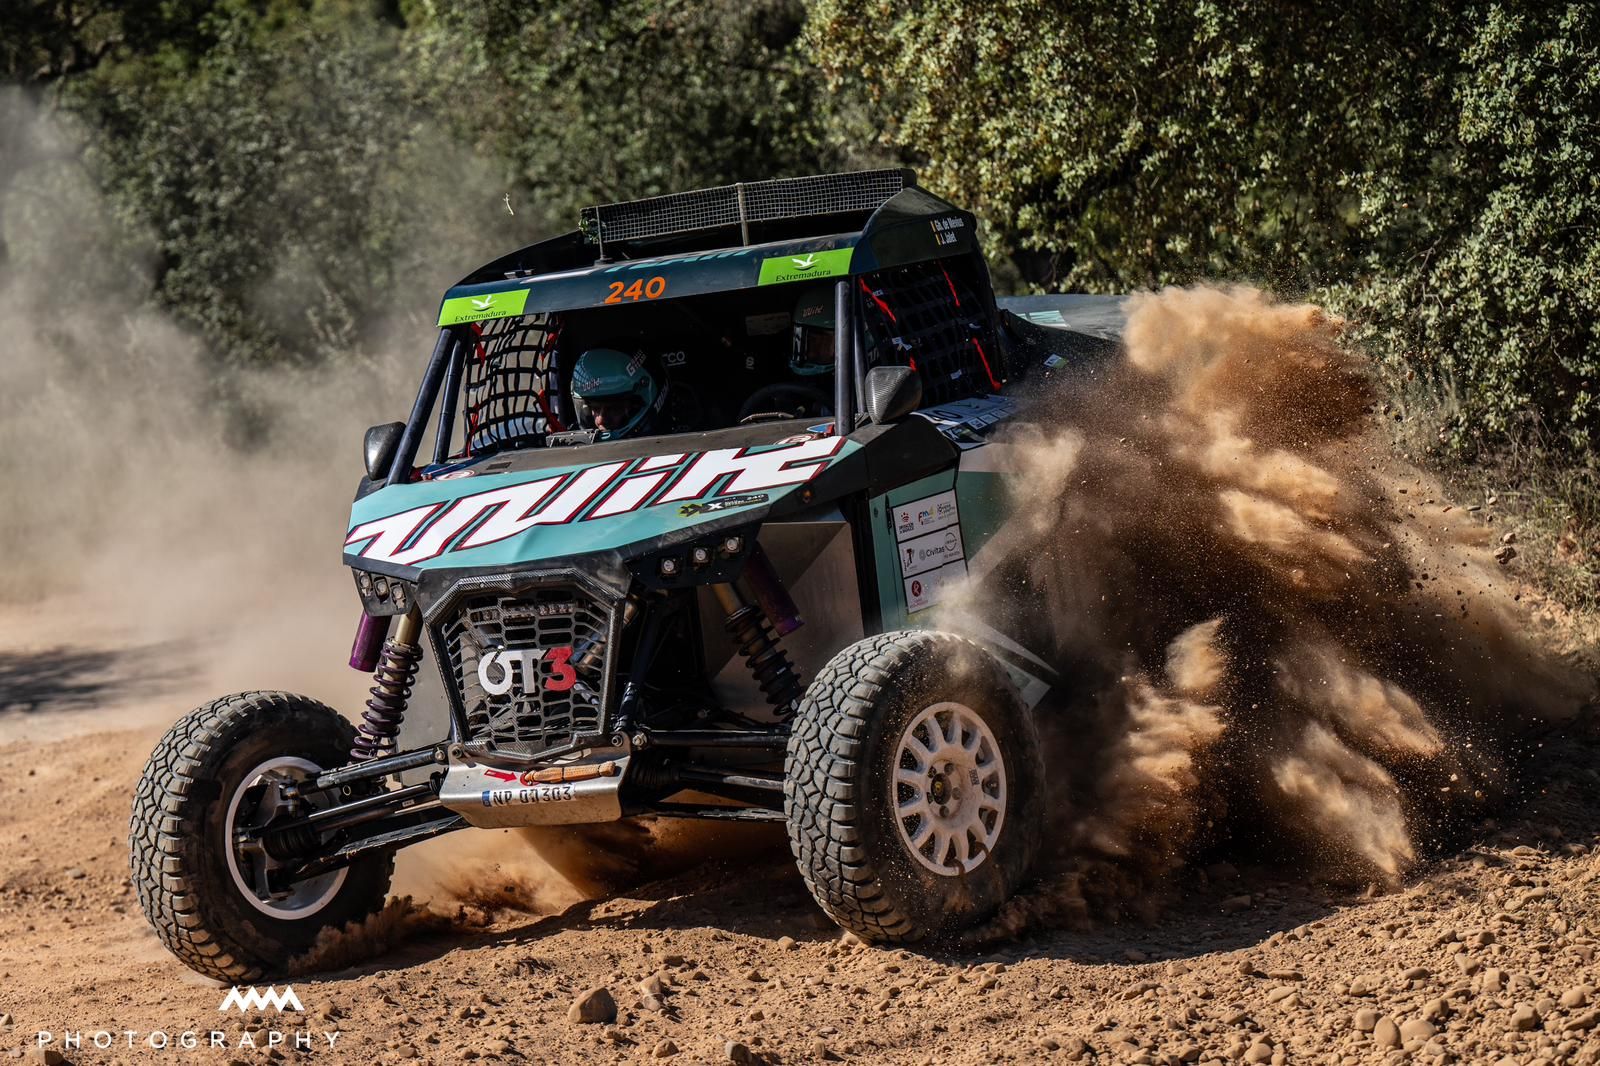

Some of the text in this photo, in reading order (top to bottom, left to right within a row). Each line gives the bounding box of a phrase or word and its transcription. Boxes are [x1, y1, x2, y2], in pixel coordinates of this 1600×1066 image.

[774, 268, 832, 282] Extremadura
[604, 275, 667, 305] 240
[454, 309, 507, 323] Extremadura
